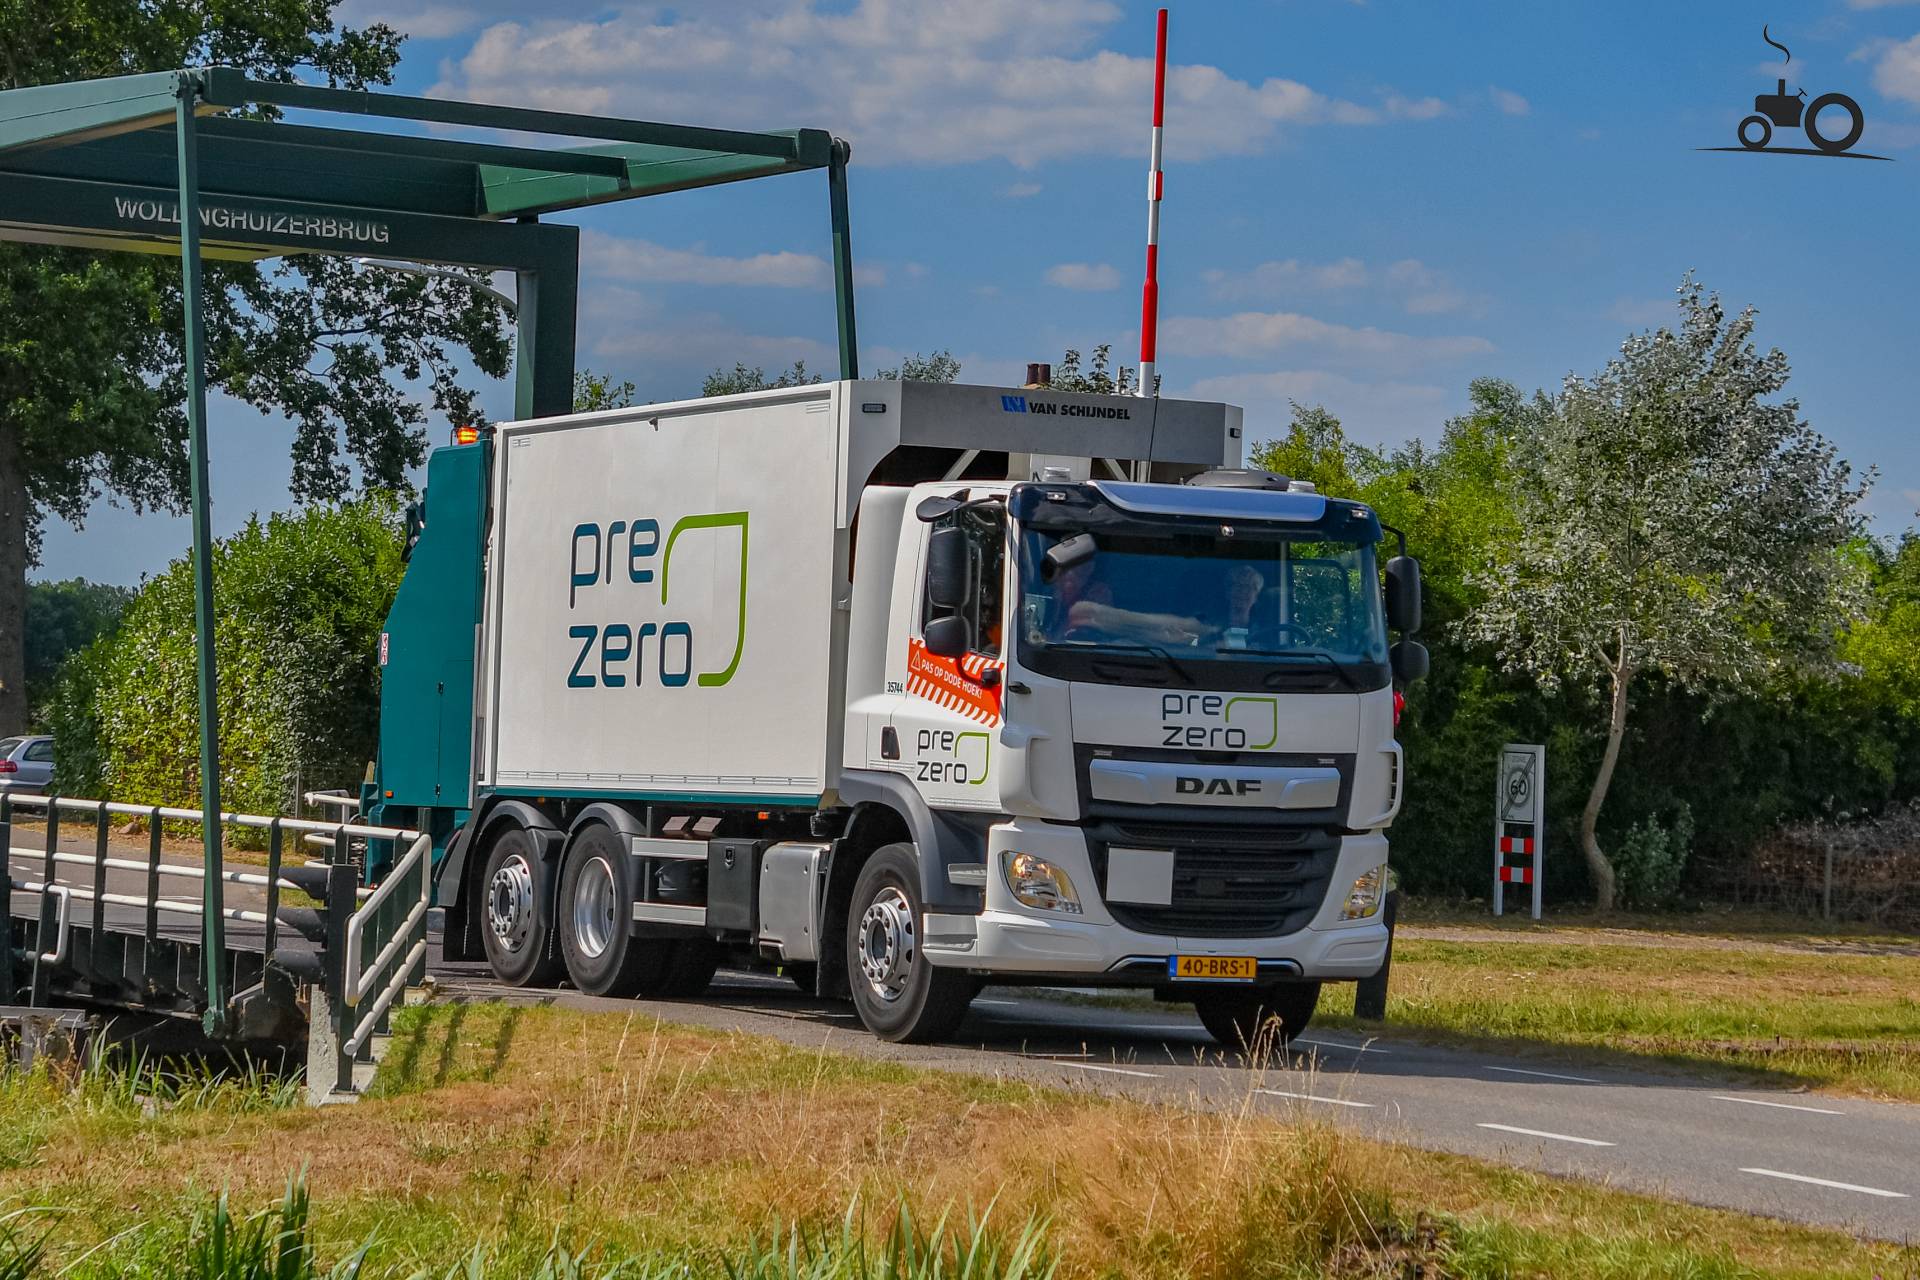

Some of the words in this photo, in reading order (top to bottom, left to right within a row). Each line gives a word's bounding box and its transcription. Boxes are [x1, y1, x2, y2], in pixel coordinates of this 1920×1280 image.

[114, 196, 390, 244] WOLLNGHUIZERBRUG
[1029, 401, 1057, 415] VAN
[1061, 404, 1130, 420] SCHIJNDEL
[569, 518, 661, 610] pre
[567, 621, 693, 688] zero
[921, 658, 934, 674] PAS
[934, 665, 944, 678] OP
[943, 670, 962, 689] DODE
[1162, 693, 1223, 721] pre
[917, 729, 954, 756] pre
[1162, 726, 1246, 748] zero
[916, 761, 968, 784] zero
[1176, 776, 1262, 796] DAF
[1511, 779, 1527, 796] 60
[1183, 959, 1250, 975] 40-BRS-1
